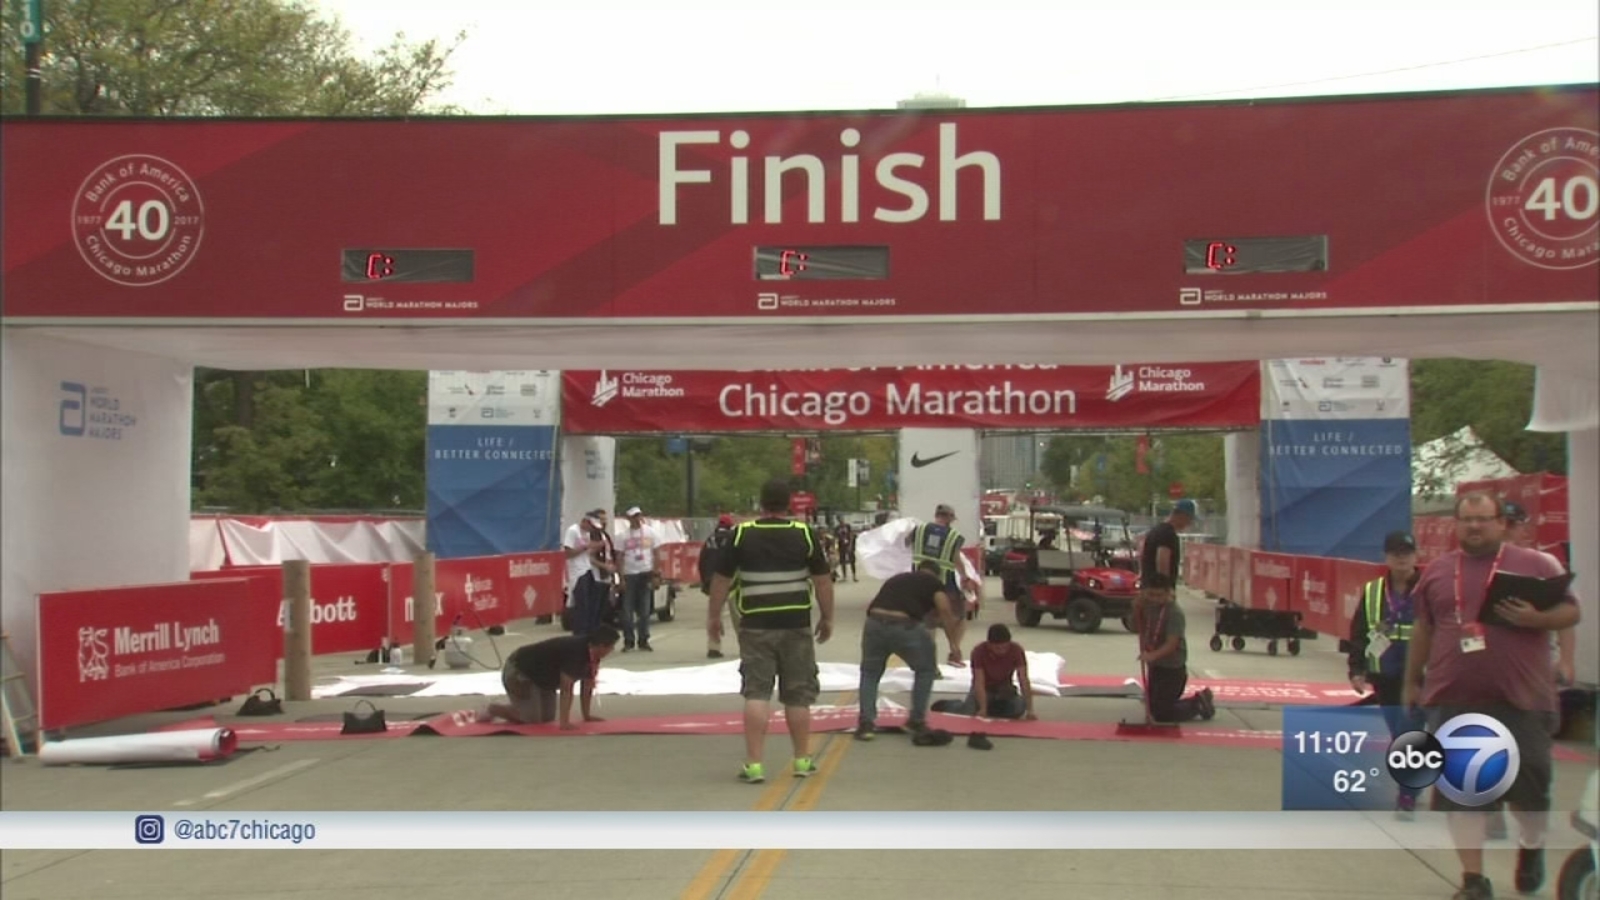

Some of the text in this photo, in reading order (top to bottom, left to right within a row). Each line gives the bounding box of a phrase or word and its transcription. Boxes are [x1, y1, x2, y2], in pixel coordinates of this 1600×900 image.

[1502, 149, 1536, 181] Bank
[1540, 137, 1558, 153] of
[659, 122, 1001, 224] Finish
[85, 163, 190, 202] Bank of America
[1525, 175, 1599, 221] 40
[105, 200, 170, 240] 40
[174, 215, 199, 225] 2017
[1504, 217, 1556, 258] Chicago
[86, 235, 191, 276] Chicago Marathon
[861, 298, 896, 306] MAJORS
[1237, 292, 1288, 301] MARATHON
[1290, 291, 1327, 300] MAJORS
[395, 301, 442, 309] MARATHON
[444, 301, 479, 309] MAJORS
[622, 372, 672, 387] Chicago
[1139, 367, 1191, 380] Chicago
[622, 386, 684, 397] Marathon
[1139, 380, 1205, 391] Marathon
[719, 380, 1076, 425] Chicago Marathon
[478, 437, 503, 447] LIFE
[1314, 432, 1342, 442] LIFE
[435, 449, 480, 460] BETTER
[1322, 445, 1402, 455] CONNECTED
[114, 618, 220, 655] Merrill Lynch
[115, 653, 225, 678] Bank of America Corporation
